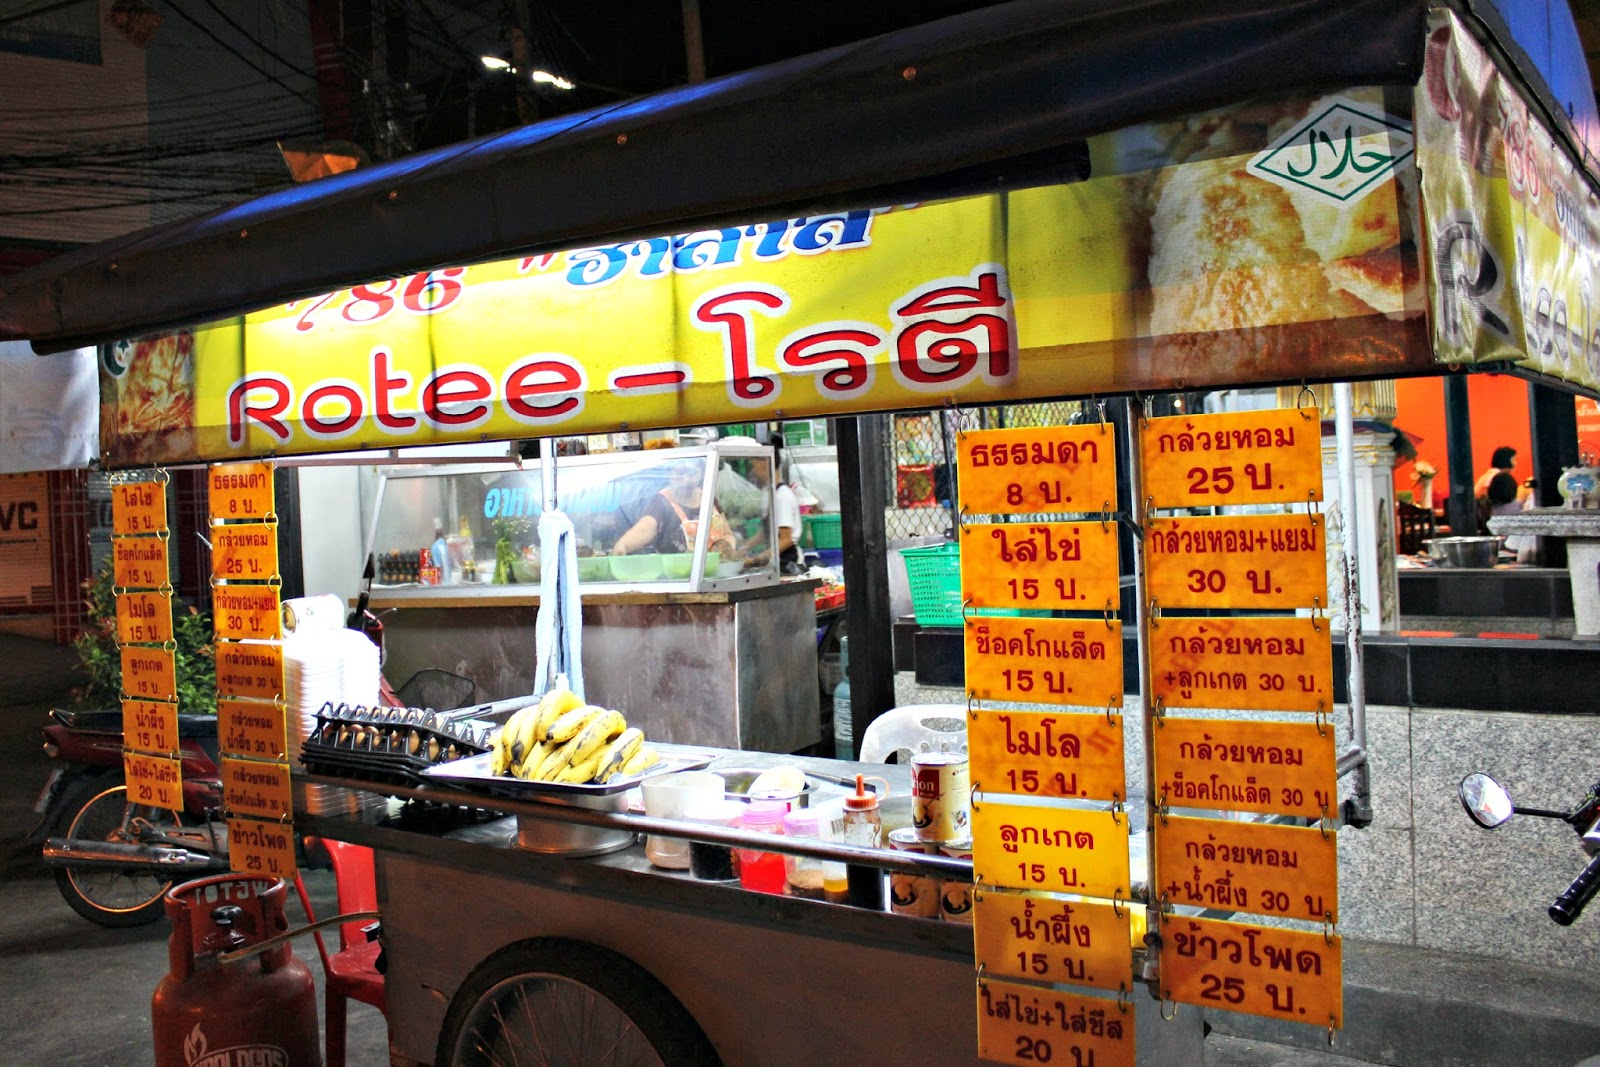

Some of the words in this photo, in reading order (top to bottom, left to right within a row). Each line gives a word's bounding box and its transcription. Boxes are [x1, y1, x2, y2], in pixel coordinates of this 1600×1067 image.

[1287, 125, 1395, 179] حلال
[230, 352, 582, 443] Rotee
[697, 273, 1010, 399] โรตี
[1159, 423, 1295, 453] กล้วยหอม
[970, 438, 1098, 468] ธรรมดา
[214, 473, 266, 490] ธรรมดา
[1188, 467, 1233, 494] 25
[1006, 483, 1023, 505] 8
[229, 499, 237, 513] 8
[127, 516, 139, 530] 15
[219, 529, 268, 547] กล้วยหอม
[992, 527, 1081, 562] ใส่ไข่
[1152, 520, 1316, 554] กล้วยหอม+แยม
[127, 570, 140, 584] 15
[226, 559, 243, 574] 25
[1008, 578, 1039, 600] 15
[1188, 569, 1226, 594] 30
[126, 595, 155, 619] ไมโล
[130, 626, 142, 641] 15
[228, 615, 242, 630] 30
[1169, 625, 1305, 656] กล้วยหอม
[137, 681, 148, 693] 15
[256, 677, 267, 688] 30
[1002, 669, 1034, 692] 15
[1259, 673, 1285, 691] 30
[137, 732, 150, 747] 15
[999, 716, 1081, 759] ไมโล
[1180, 734, 1303, 766] กล้วยหอม
[138, 784, 152, 800] 20
[1006, 769, 1039, 793] 15
[1281, 788, 1303, 806] 30
[232, 822, 287, 850] ข้าวโพด
[1185, 833, 1298, 868] กล้วยหอม
[246, 855, 262, 870] 25
[1018, 862, 1046, 883] 15
[1261, 890, 1290, 912] 30
[1010, 899, 1091, 948] น้ำผึ้ง
[1174, 922, 1322, 976] ข้าวโพด
[1017, 952, 1048, 974] 15
[1200, 974, 1245, 1004] 25
[1015, 1035, 1052, 1063] 20
